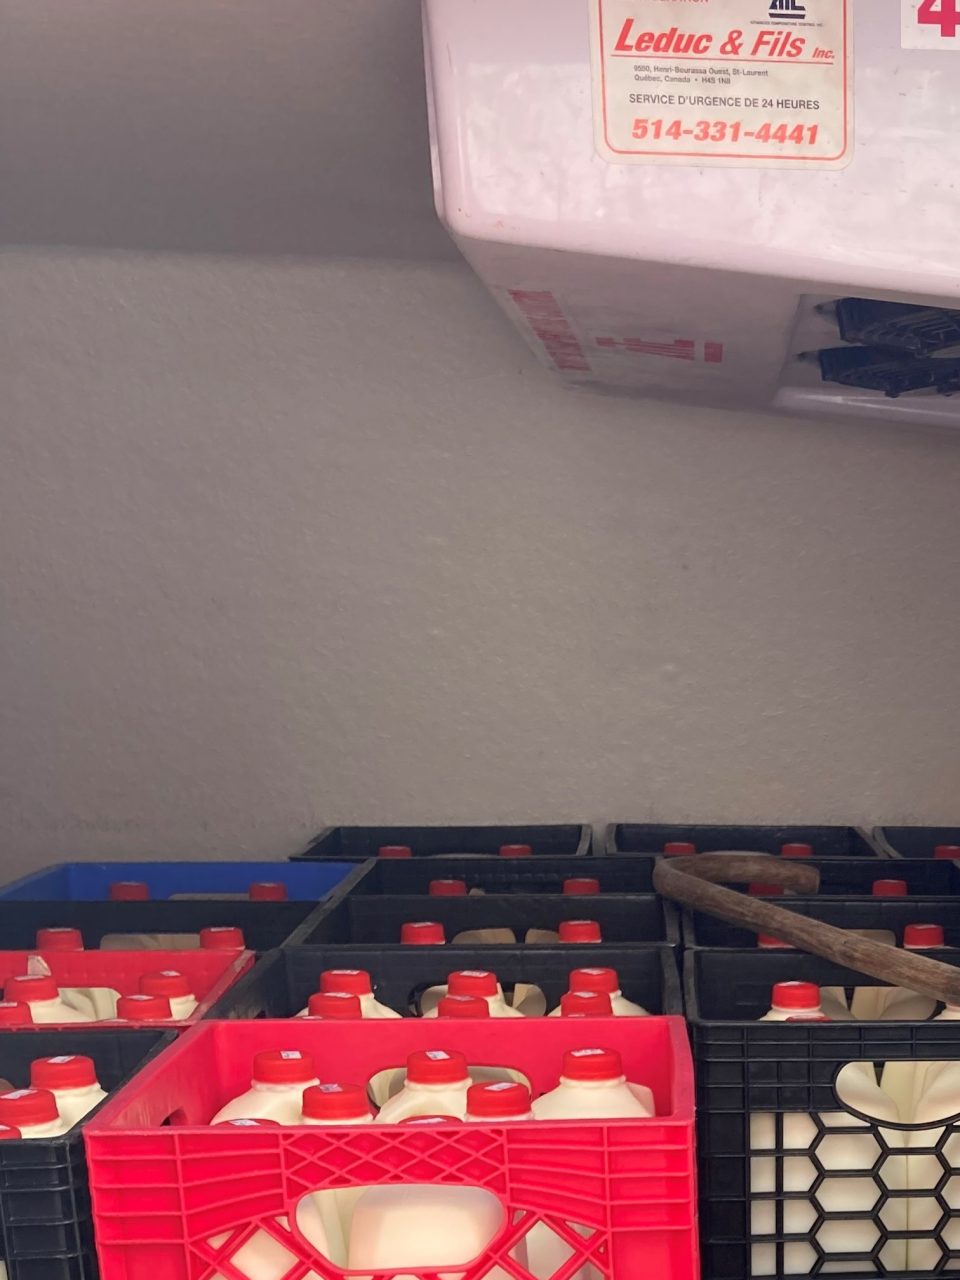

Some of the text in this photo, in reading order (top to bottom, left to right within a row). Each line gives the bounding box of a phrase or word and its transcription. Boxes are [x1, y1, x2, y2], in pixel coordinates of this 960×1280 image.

[614, 18, 836, 60] Leduc & Fils Inc.
[629, 93, 821, 110] SERVICE D'URGENCE DE 24 HEURES
[631, 118, 819, 145] 514-331-4441
